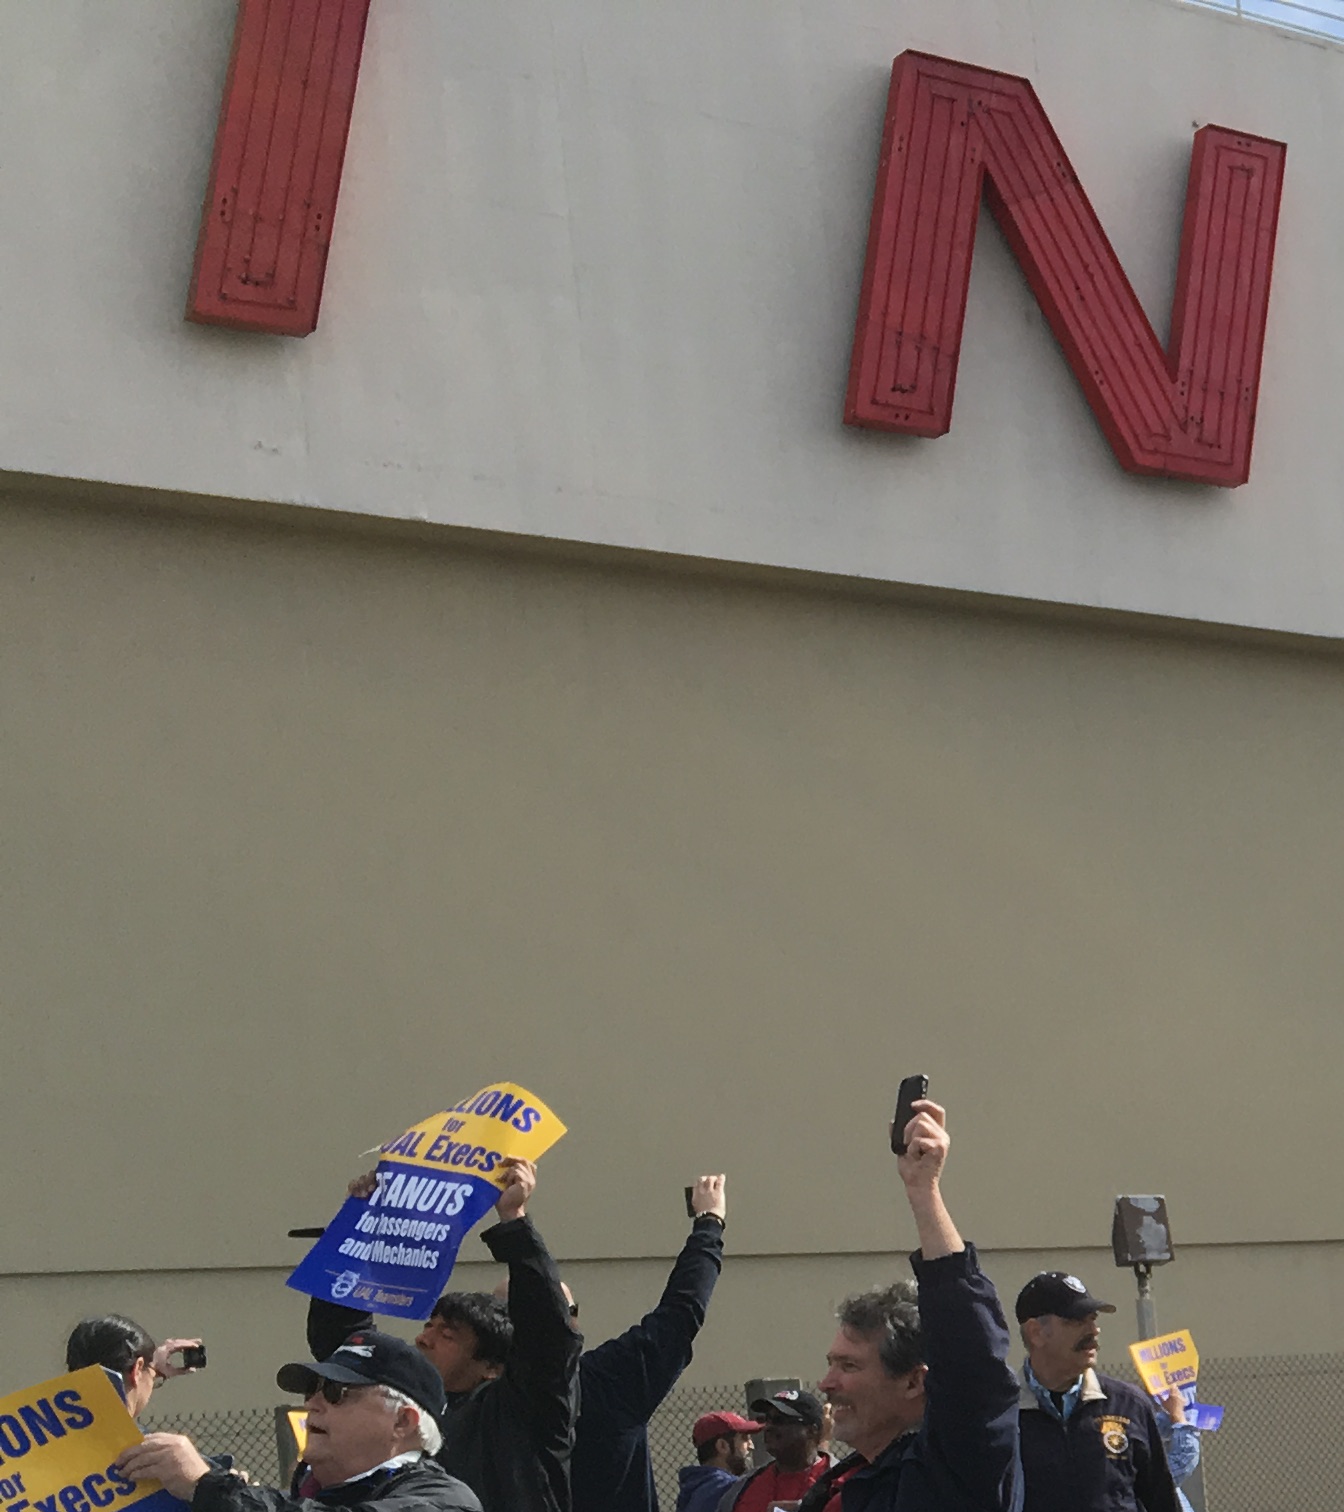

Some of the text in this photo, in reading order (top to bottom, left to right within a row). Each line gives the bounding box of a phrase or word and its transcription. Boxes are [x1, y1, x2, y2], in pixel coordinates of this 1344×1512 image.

[442, 1117, 466, 1133] for
[445, 1091, 541, 1133] LIONS
[423, 1134, 502, 1172] Execs
[338, 1237, 440, 1269] and Mechanics
[0, 1389, 94, 1466] ONS
